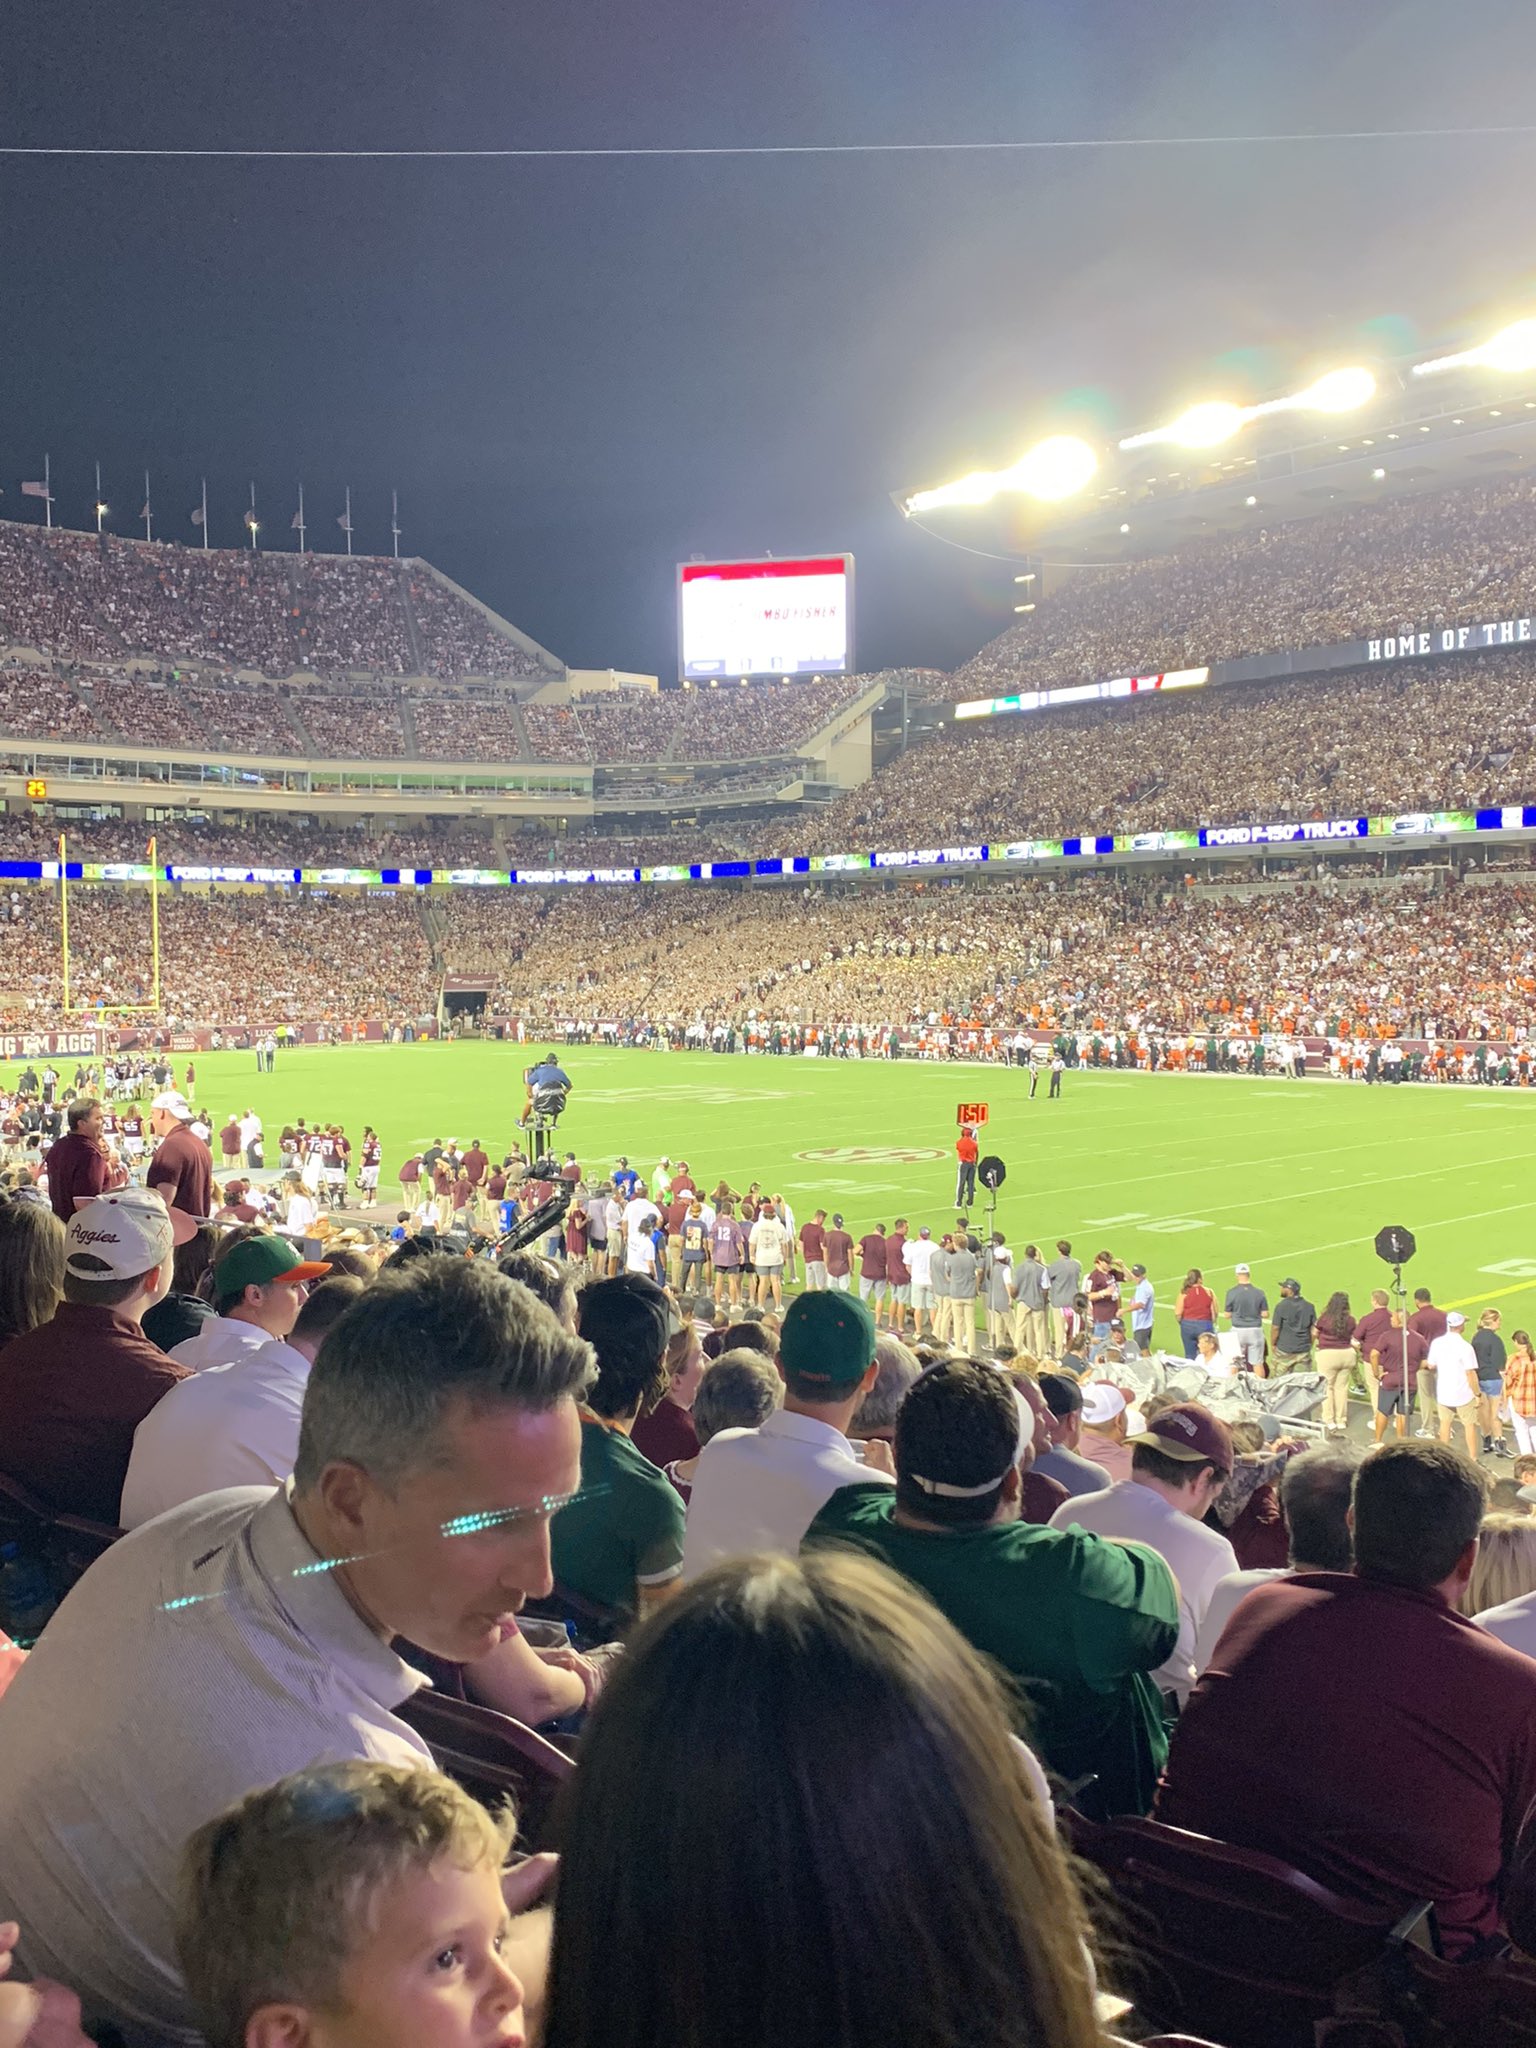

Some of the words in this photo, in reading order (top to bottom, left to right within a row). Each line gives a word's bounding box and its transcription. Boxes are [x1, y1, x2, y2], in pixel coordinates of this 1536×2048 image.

[1368, 632, 1430, 660] HOME
[1442, 627, 1470, 650] OF
[1482, 618, 1531, 645] THE
[27, 780, 46, 796] 25
[1205, 828, 1250, 845] FORD
[1301, 819, 1359, 839] TRUCK
[875, 851, 907, 866] FORD
[941, 845, 982, 862] TRUCK
[251, 867, 294, 882] TRUCK
[591, 868, 635, 882] TRUCK
[56, 1033, 93, 1053] AGG
[1081, 1212, 1216, 1233] 10
[70, 1223, 121, 1245] Aggies
[717, 1226, 731, 1241] 12
